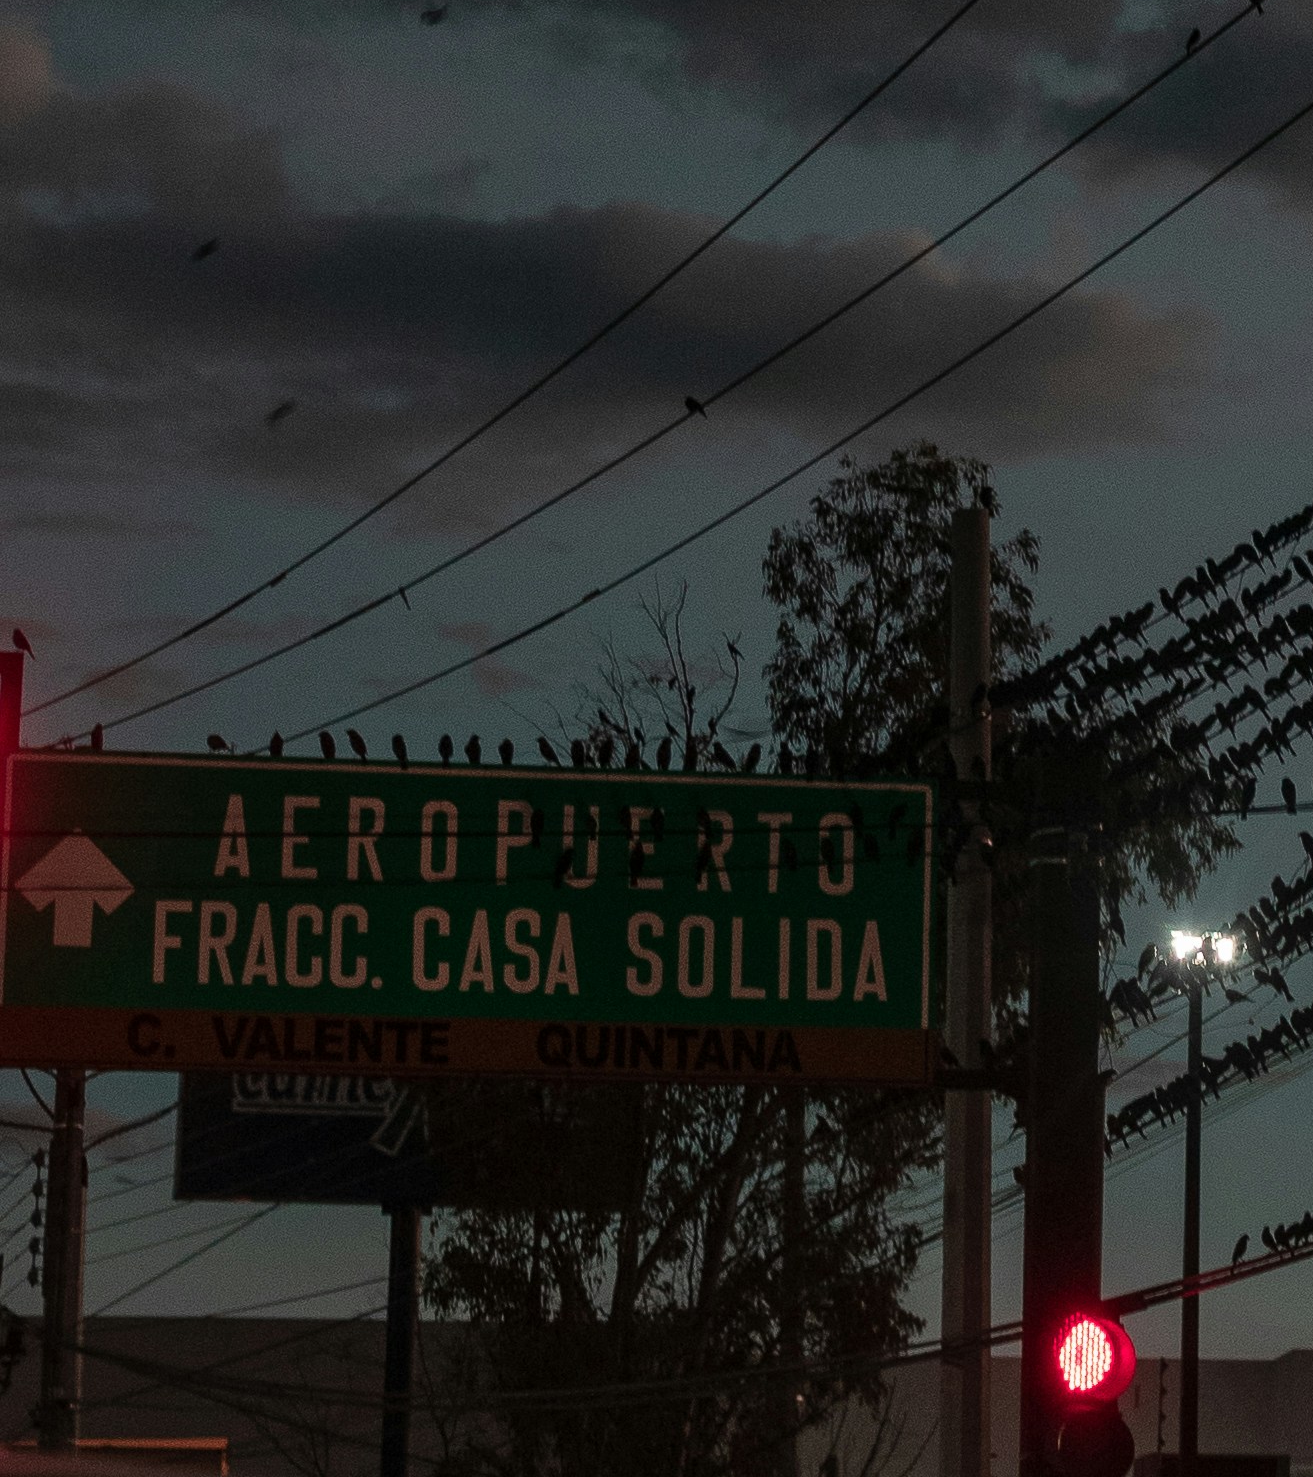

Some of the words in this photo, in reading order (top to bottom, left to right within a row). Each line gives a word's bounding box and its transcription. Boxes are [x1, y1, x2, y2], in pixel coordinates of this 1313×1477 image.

[213, 793, 857, 898] AEROPUERTO
[151, 898, 384, 991] FRACC.
[411, 905, 580, 996] CASA
[625, 910, 889, 1003] SOLIDA
[127, 1013, 176, 1059] C.
[211, 1016, 452, 1065] VALENTE
[536, 1023, 803, 1073] QUINTANA
